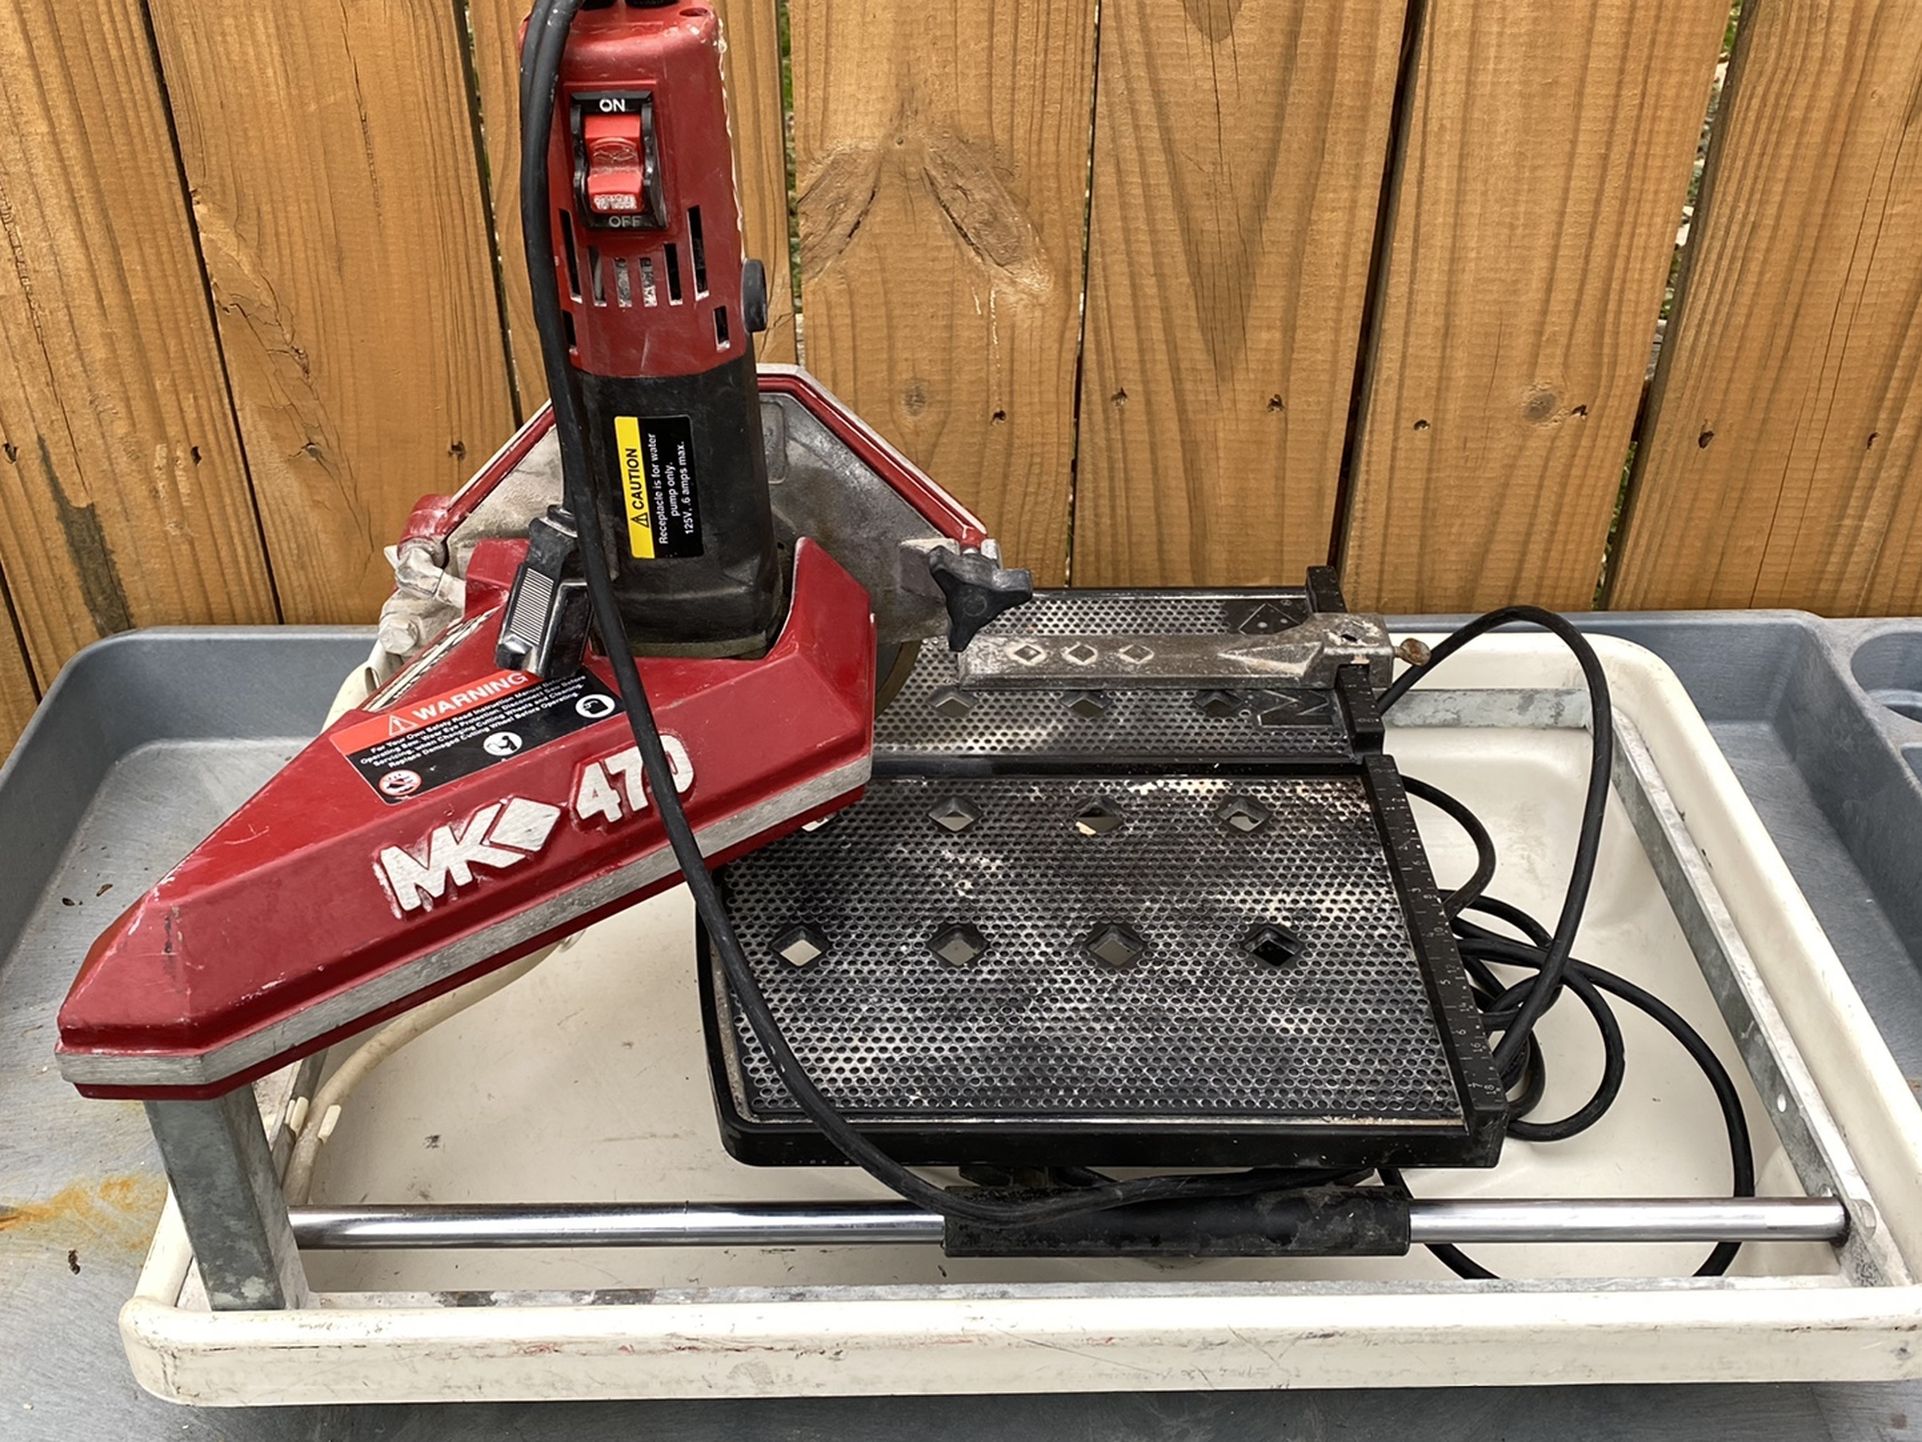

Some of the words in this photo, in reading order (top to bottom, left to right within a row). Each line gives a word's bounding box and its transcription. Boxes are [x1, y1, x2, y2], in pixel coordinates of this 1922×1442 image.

[599, 98, 626, 112] ON
[608, 215, 641, 228] OFF
[648, 433, 659, 461] water
[677, 441, 686, 466] max.
[625, 448, 644, 510] CAUTION
[651, 464, 661, 479] for
[652, 480, 662, 489] is
[665, 461, 677, 487] only.
[680, 468, 691, 496] amps
[654, 491, 669, 544] Receptacle
[668, 488, 681, 517] pump
[411, 672, 529, 721] WARNING
[360, 747, 402, 764] Operating
[442, 724, 459, 733] Eye
[501, 691, 544, 710] Disconnect
[561, 675, 586, 687] Before
[370, 745, 385, 753] For
[385, 738, 406, 747] Your
[406, 730, 426, 740] Own
[425, 720, 452, 732] Safety
[451, 712, 474, 722] Read
[473, 697, 515, 715] Instruction
[437, 726, 476, 742] Changing
[476, 713, 506, 728] Cutting
[504, 702, 533, 716] Wheels
[388, 753, 422, 768] Replace
[422, 737, 460, 755] Damaged
[460, 726, 490, 740] Cutting
[490, 715, 515, 729] Wheel
[514, 706, 541, 719] Before
[572, 734, 695, 824] 470
[378, 800, 527, 912] MK
